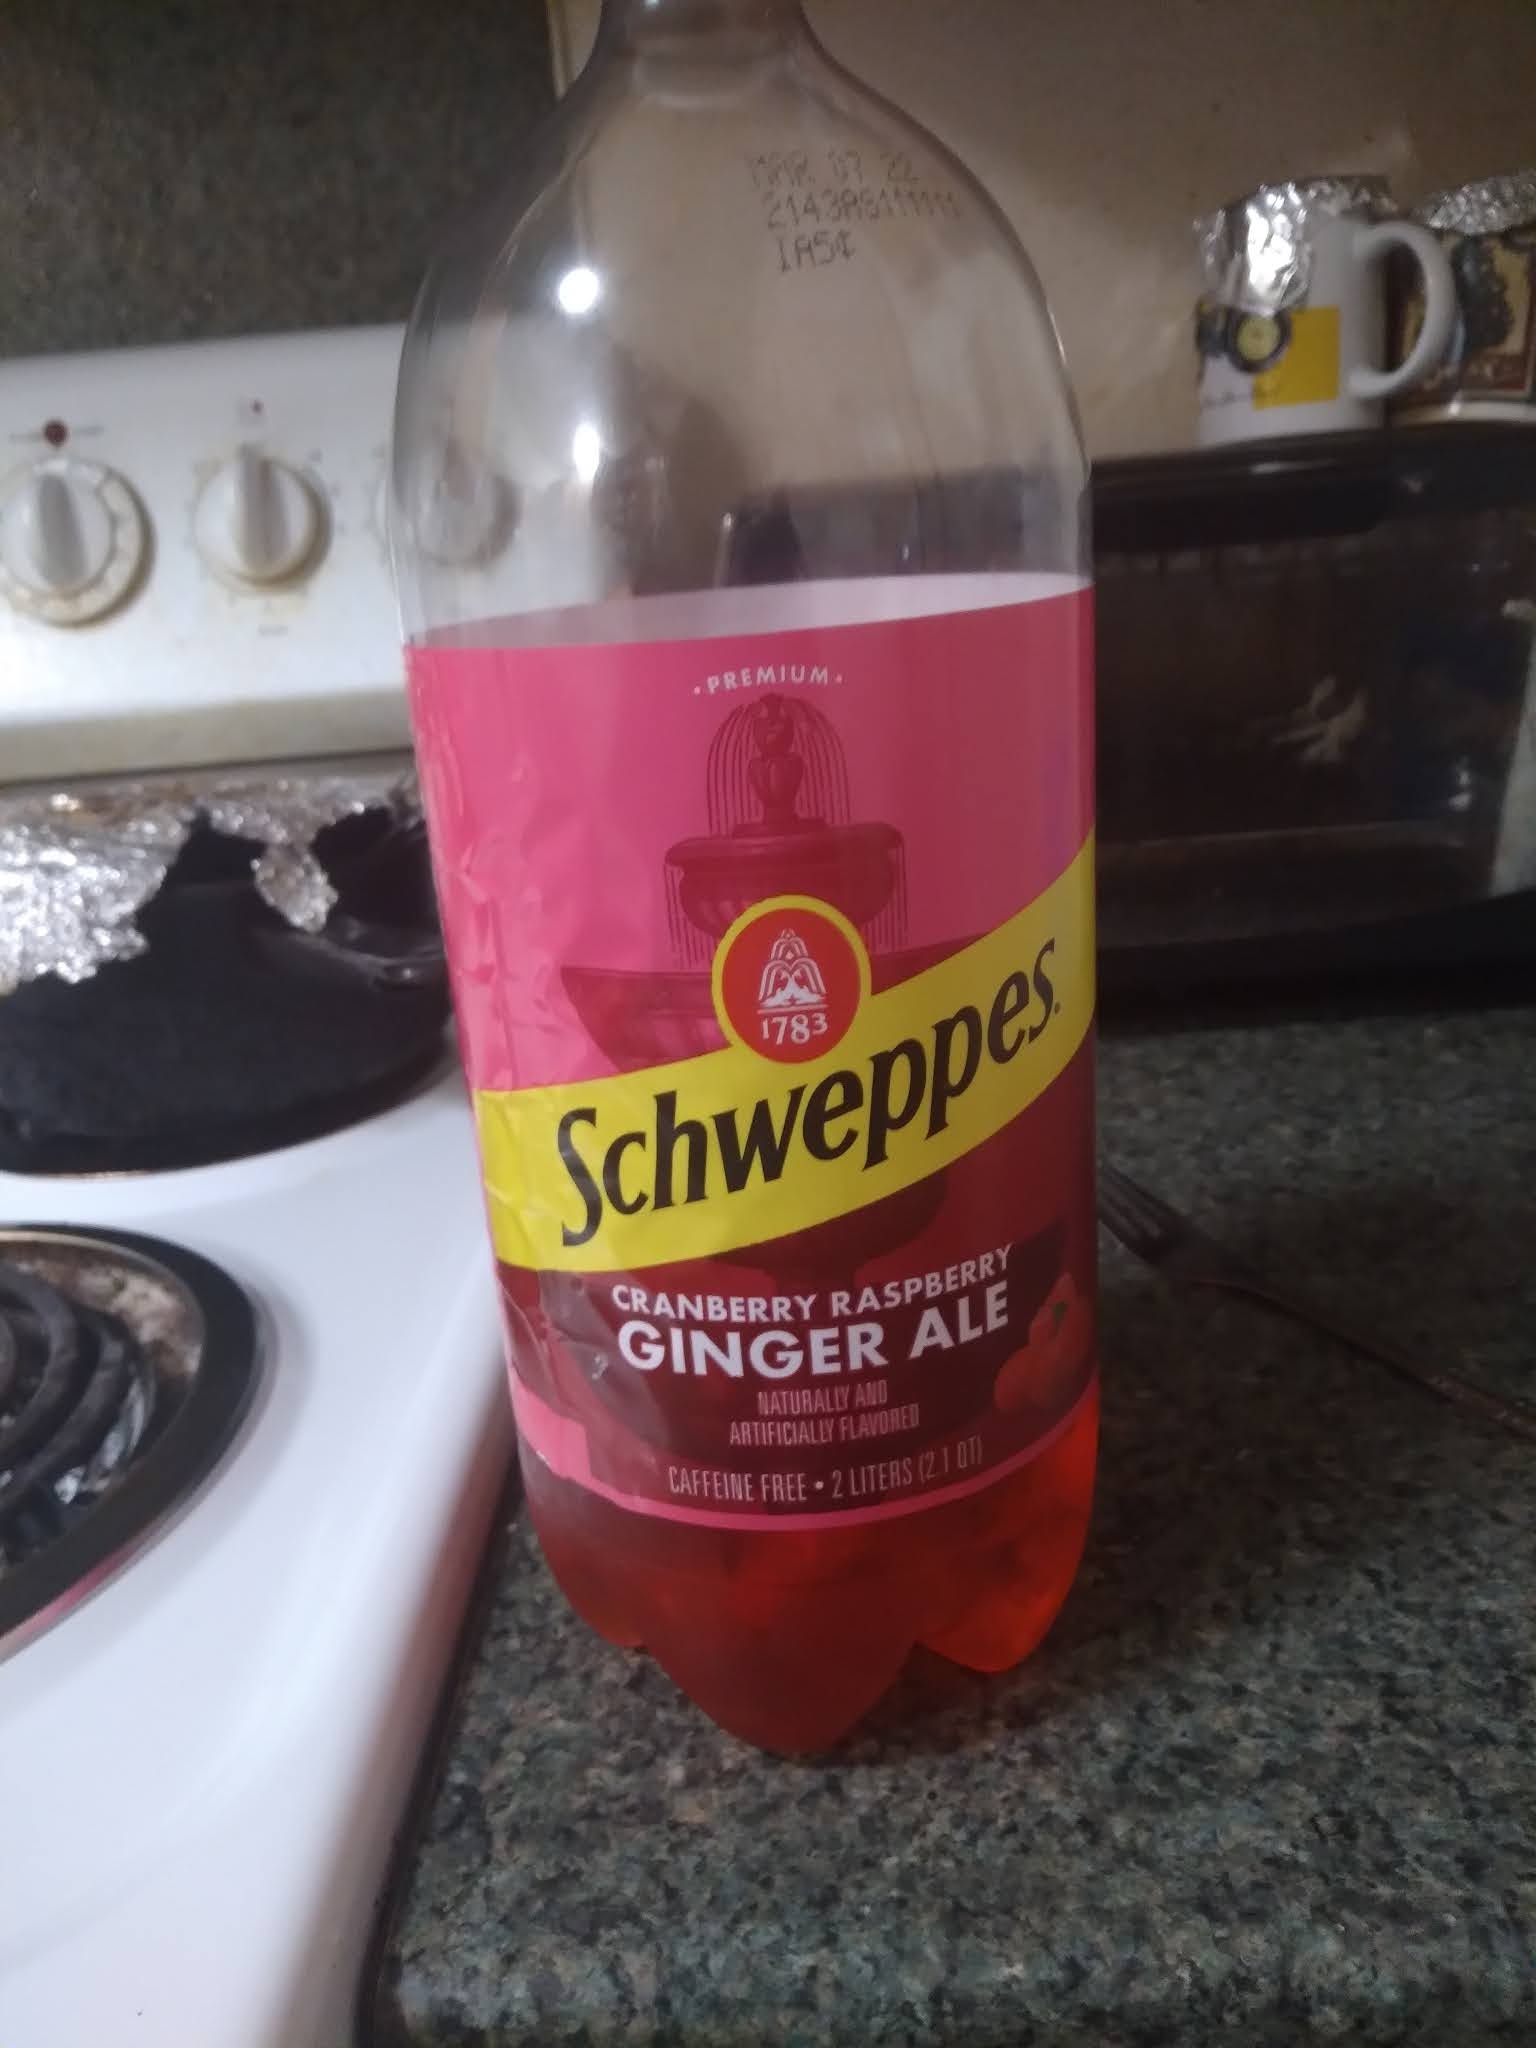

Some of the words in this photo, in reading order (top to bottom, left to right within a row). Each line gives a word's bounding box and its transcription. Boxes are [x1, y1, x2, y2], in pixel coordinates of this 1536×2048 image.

[707, 664, 828, 694] PREMIUM
[762, 1012, 828, 1045] 1783
[557, 938, 1055, 1247] Schweppes
[611, 1284, 817, 1323] CRANBERRY
[831, 1243, 1014, 1317] RASPBERRY
[618, 1320, 888, 1379] GINGER
[908, 1281, 1009, 1359] ALE
[756, 1384, 850, 1416] NATURALLY
[855, 1379, 888, 1406] AND
[729, 1417, 835, 1446] ARTIFICIALLY
[839, 1403, 920, 1441] FLAVORED
[668, 1465, 754, 1501] CAFFEINE
[761, 1472, 808, 1501] FREE
[831, 1470, 844, 1498] 2
[850, 1457, 913, 1496] LITERS
